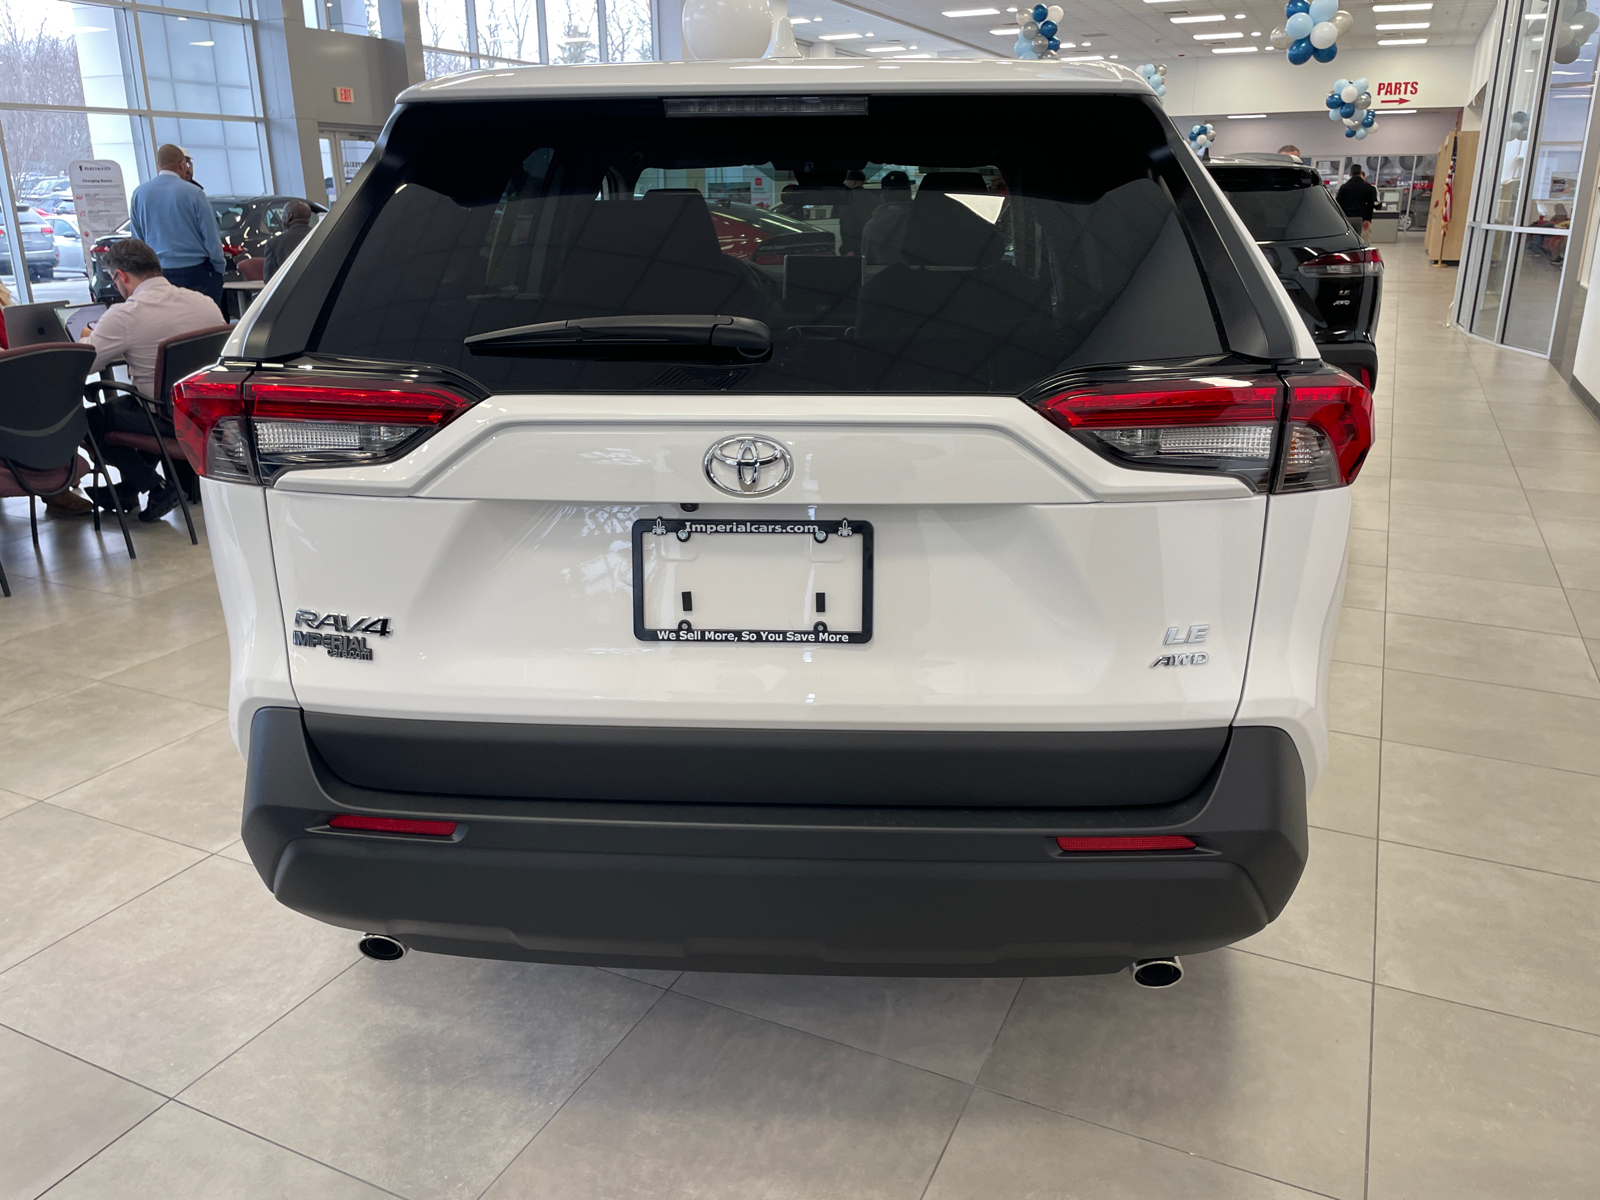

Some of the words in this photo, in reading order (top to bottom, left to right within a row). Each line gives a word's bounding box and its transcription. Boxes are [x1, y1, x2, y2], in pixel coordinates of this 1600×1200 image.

[340, 88, 351, 101] EXIT
[1377, 81, 1419, 96] PARTS
[684, 522, 819, 534] Imperialcars.com
[294, 608, 394, 638] RAV4
[292, 630, 373, 653] IMPERIAL
[656, 630, 676, 640] We
[679, 630, 700, 640] Sell
[704, 631, 738, 642] More,
[741, 631, 757, 641] So
[760, 631, 783, 641] You
[786, 632, 816, 641] Save
[818, 632, 849, 642] More
[1163, 624, 1210, 645] LE
[326, 648, 373, 661] cars.com
[1149, 651, 1209, 669] AWD
